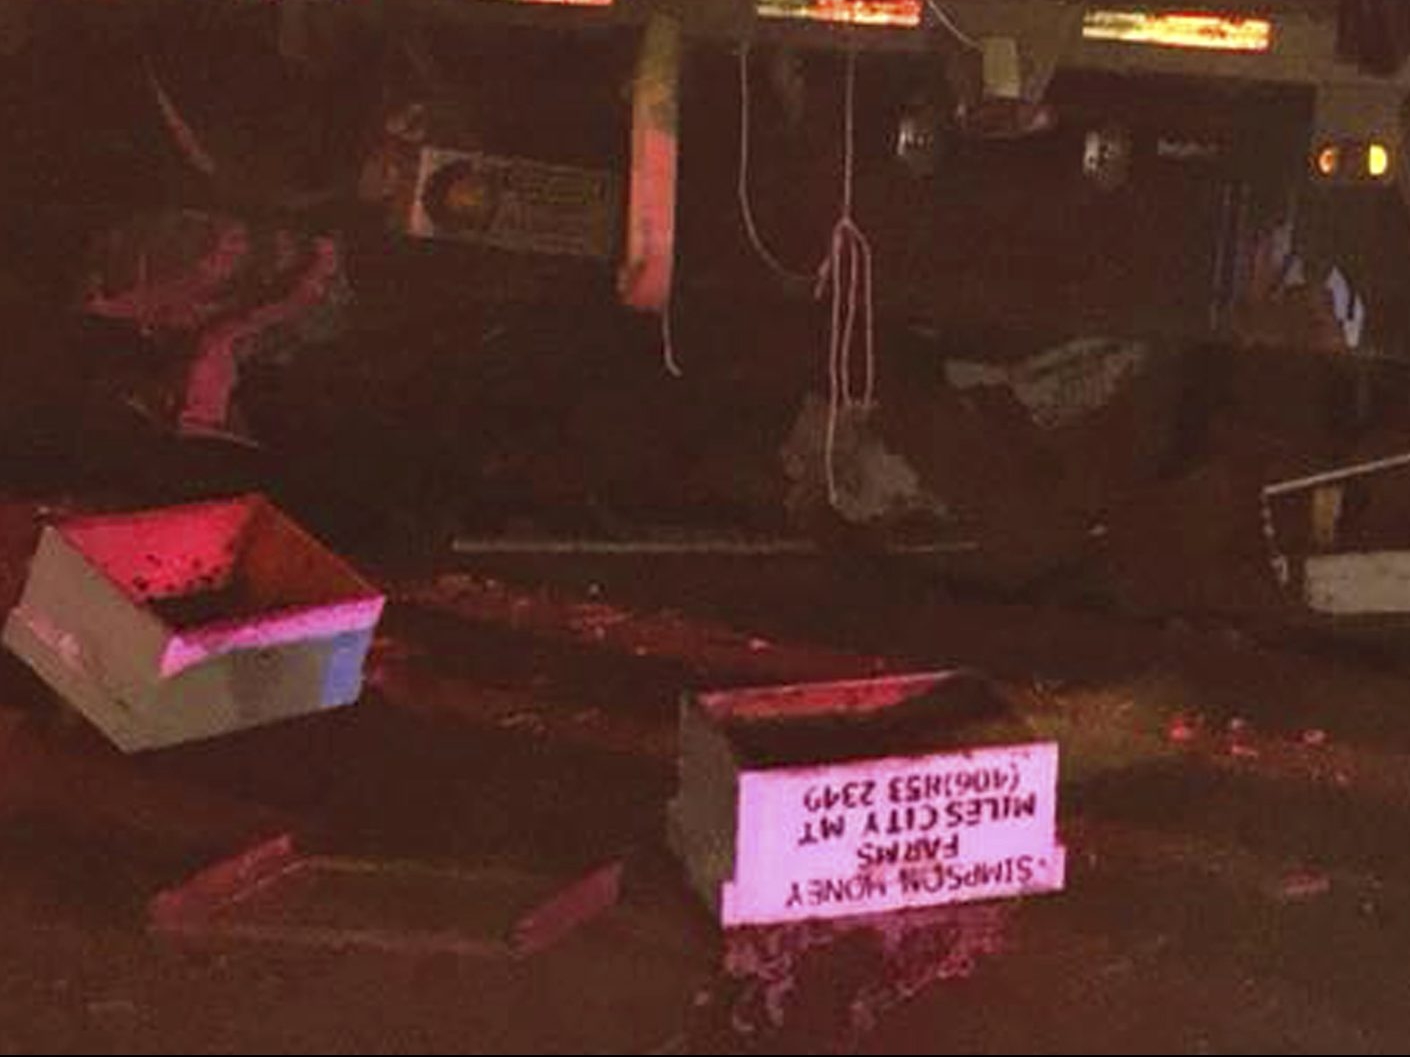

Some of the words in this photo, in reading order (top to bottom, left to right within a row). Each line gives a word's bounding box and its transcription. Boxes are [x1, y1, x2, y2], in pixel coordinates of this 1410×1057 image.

[803, 779, 878, 812] 2349
[945, 792, 1037, 828] MILES
[797, 815, 846, 846] MT
[862, 805, 940, 835] CITY
[857, 834, 960, 870] FARMS
[786, 872, 888, 908] HONEY
[900, 853, 1035, 892] SIMPSON
